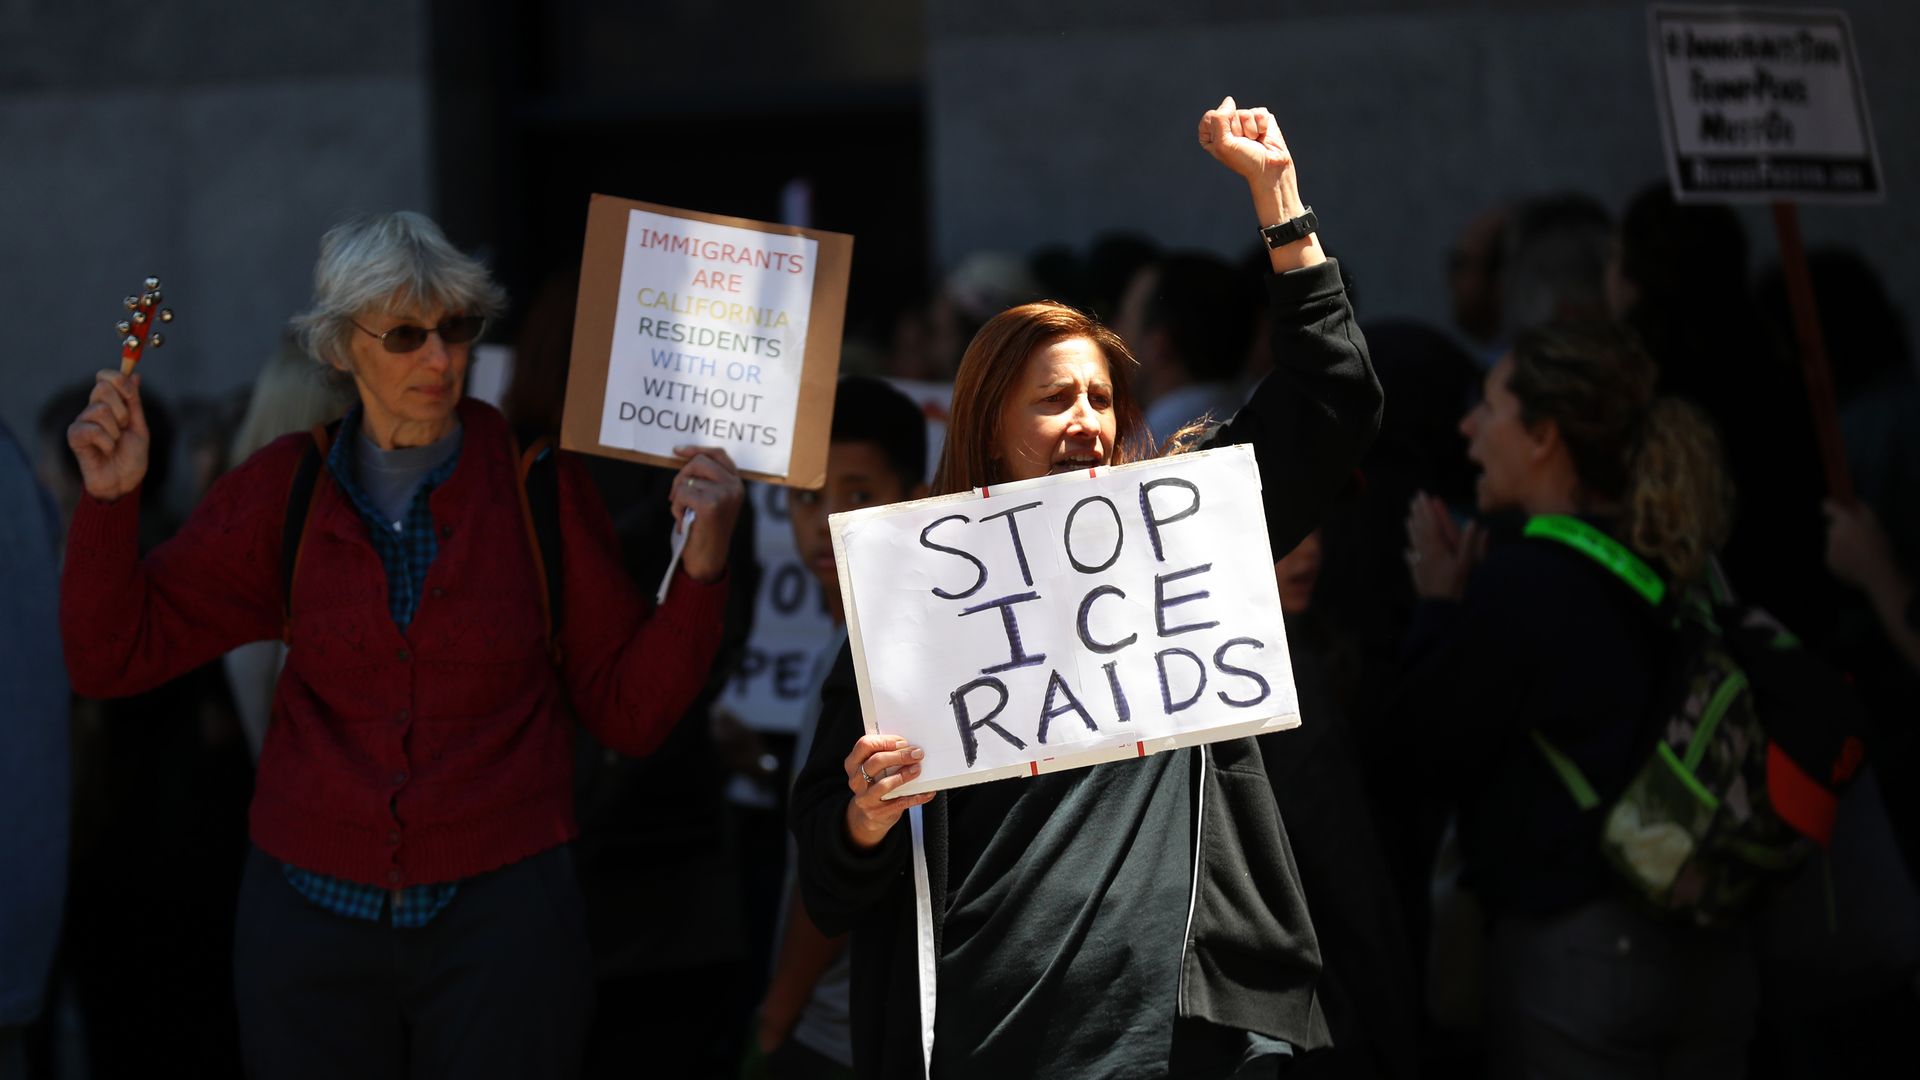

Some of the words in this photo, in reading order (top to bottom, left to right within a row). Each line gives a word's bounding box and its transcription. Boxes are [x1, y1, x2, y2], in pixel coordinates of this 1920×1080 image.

[640, 229, 804, 274] IMMIGRANTS
[692, 269, 743, 293] ARE
[637, 287, 789, 328] CALIFORNIA
[639, 317, 781, 358] RESIDENTS
[651, 348, 716, 377] WITH
[726, 362, 762, 384] OR
[643, 376, 763, 413] WITHOUT
[619, 401, 777, 446] DOCUMENTS
[920, 478, 1201, 600] STOP
[958, 563, 1221, 675] ICE
[949, 637, 1271, 768] RAIDS
